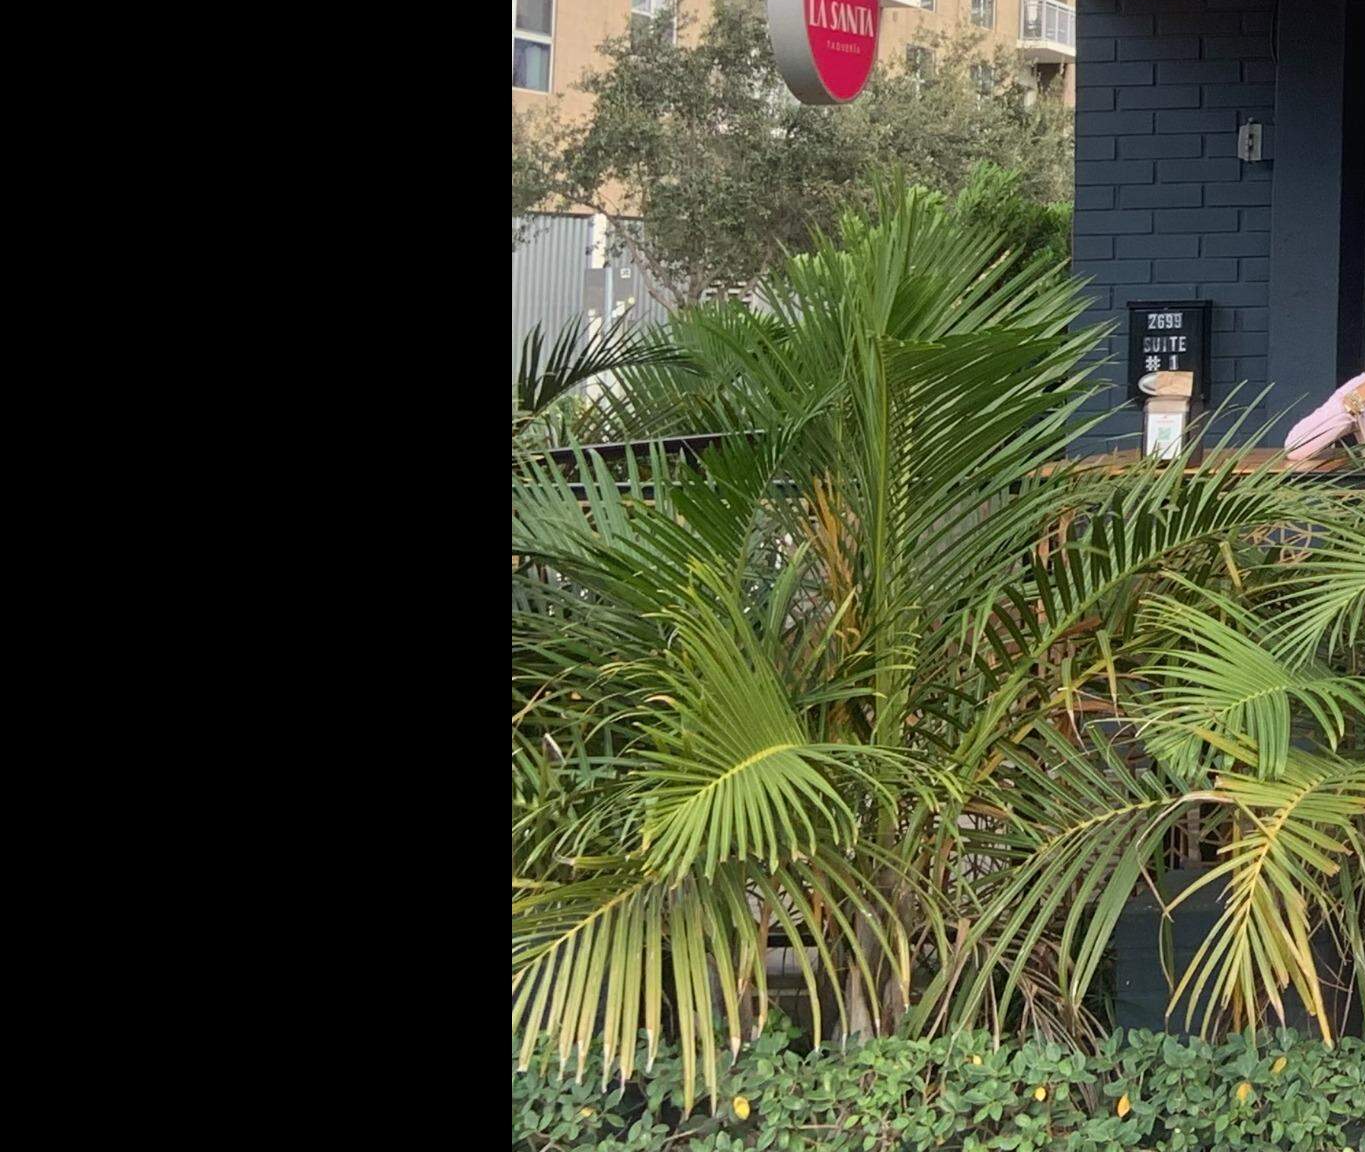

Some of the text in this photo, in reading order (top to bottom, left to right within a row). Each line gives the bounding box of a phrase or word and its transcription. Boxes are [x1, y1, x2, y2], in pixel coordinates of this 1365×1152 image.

[830, 1, 874, 38] SANTA
[1147, 312, 1183, 330] 2699
[1143, 335, 1187, 352] SUITE
